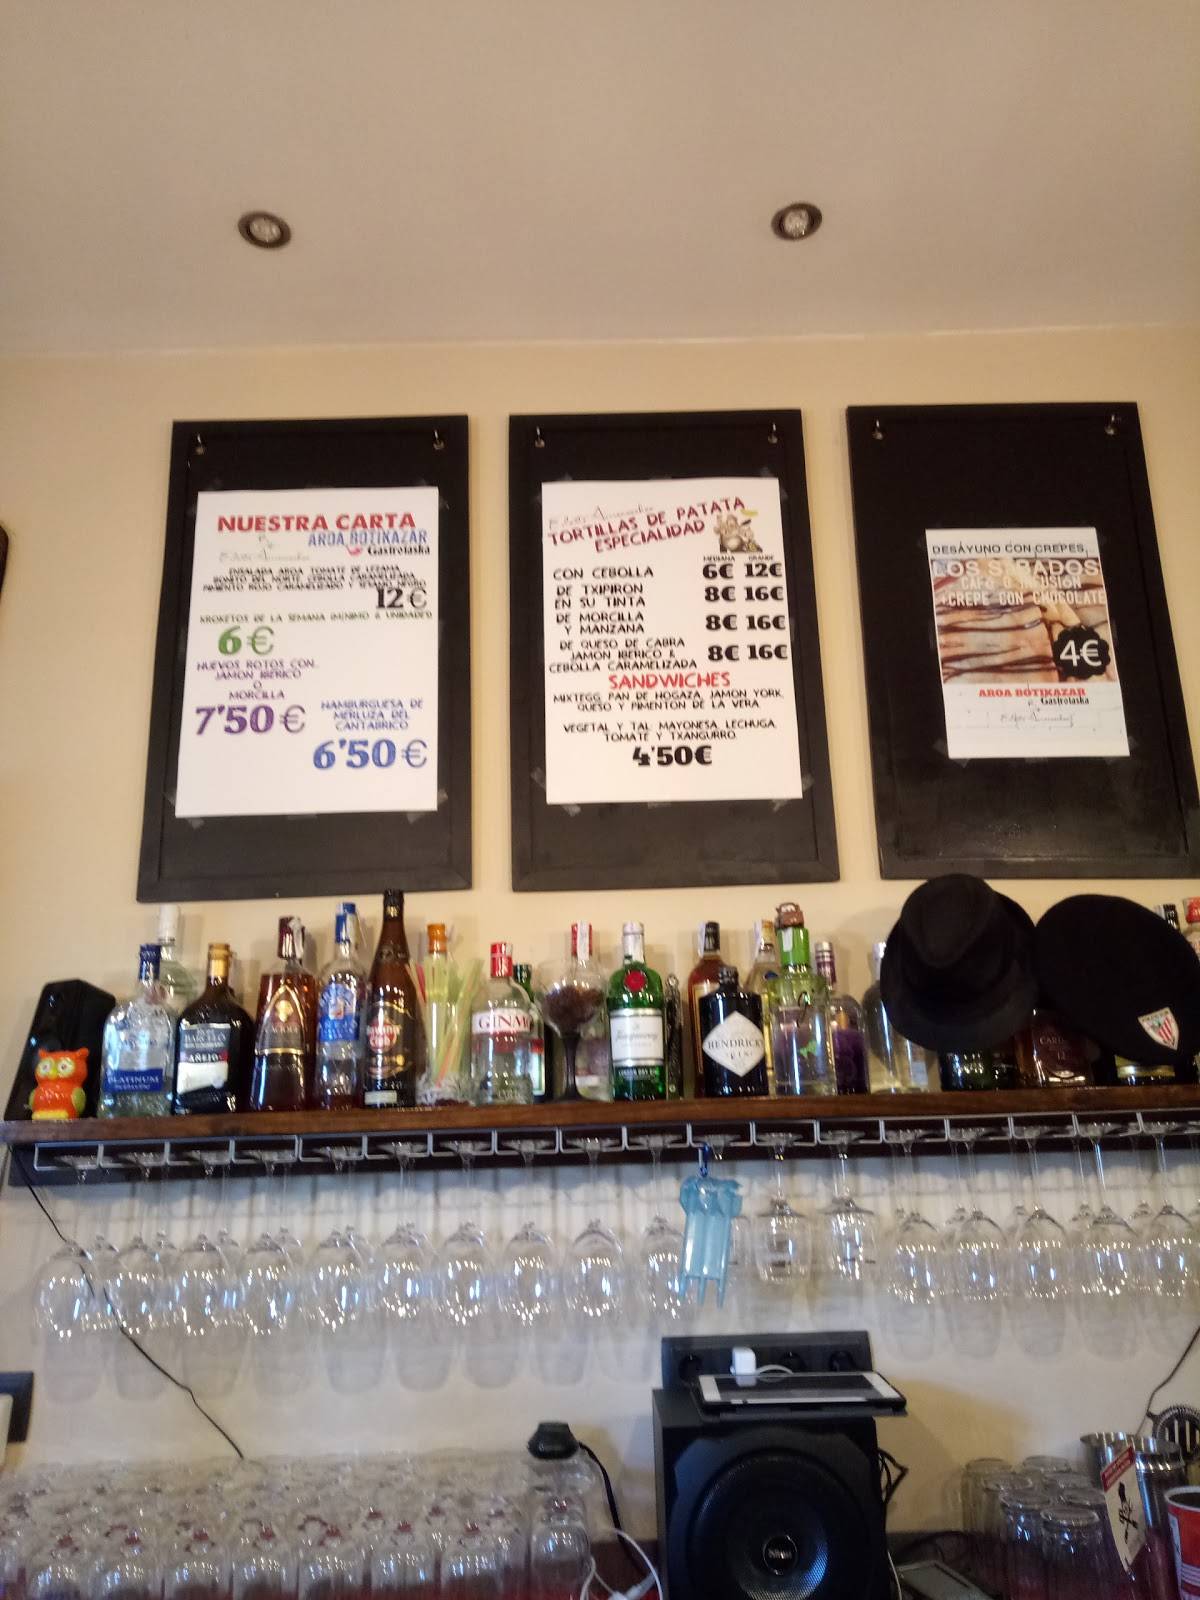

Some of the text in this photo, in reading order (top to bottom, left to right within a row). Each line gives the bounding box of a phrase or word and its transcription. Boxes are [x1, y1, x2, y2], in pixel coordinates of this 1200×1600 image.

[217, 512, 416, 532] NUESTRA CARTA
[549, 517, 638, 546] TORTILLAS
[646, 511, 666, 526] DE
[676, 497, 745, 521] PATATA
[308, 532, 344, 547] AROA
[594, 520, 705, 553] ESPECIALIDAD
[1005, 541, 1031, 553] CON
[553, 566, 654, 581] CON CEBOLLA
[702, 562, 783, 580] 6€ 12€
[931, 559, 981, 578] LOS
[556, 583, 644, 597] DE TXIPIRON
[704, 586, 784, 602] 8€ 16€
[554, 595, 646, 610] EN SU TINTA
[1000, 590, 1025, 606] CON
[556, 611, 645, 624] DE MORCILLA
[705, 614, 786, 631] 8€ 16€
[564, 623, 645, 636] Y MANZANA
[560, 637, 686, 651] DE QUESO DE CABRA
[571, 650, 611, 662] JAMON
[618, 649, 662, 660] IBERICO
[708, 644, 788, 662] 8€ 16€
[1059, 639, 1102, 667] 4€
[245, 658, 285, 670] ROTOS
[549, 659, 697, 673] CEBOLLA CARAMELIZADA
[252, 680, 262, 690] O
[608, 672, 731, 690] SANDWICHES
[229, 689, 285, 700] MORCILLA
[608, 690, 630, 701] PAN
[636, 690, 649, 701] DE
[710, 688, 747, 700] JAMON
[979, 687, 1086, 698] AROA BOTIKAZAR
[321, 698, 424, 710] HAMBURGUESA DE
[577, 698, 760, 713] QUESO Y PIMENTON DE LA VERA
[333, 710, 385, 720] MERLUZA
[563, 721, 608, 734] VEGETAL
[617, 721, 625, 732] Y
[605, 731, 649, 743] TOMATE
[656, 731, 664, 741] Y
[632, 745, 713, 766] 4'50€
[188, 1051, 219, 1064] AÑEJO
[107, 1075, 160, 1084] PLATINUM
